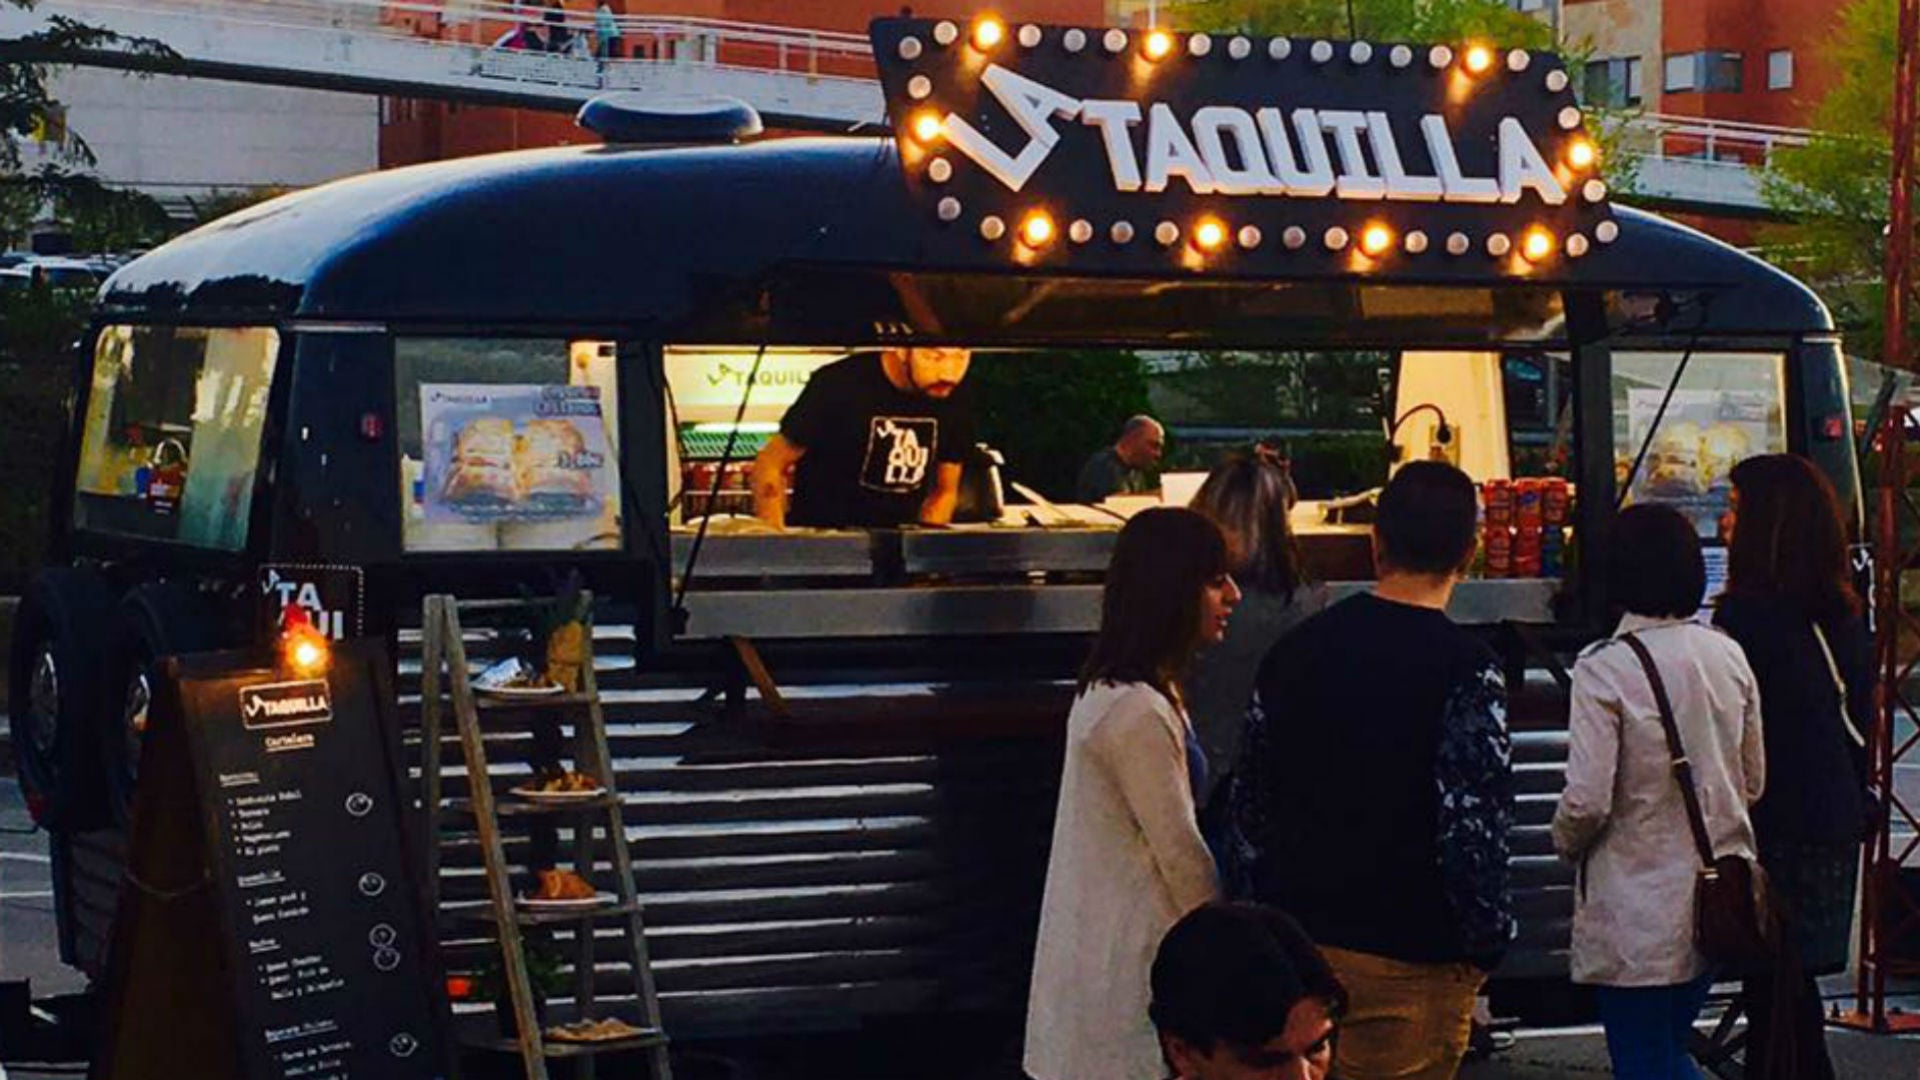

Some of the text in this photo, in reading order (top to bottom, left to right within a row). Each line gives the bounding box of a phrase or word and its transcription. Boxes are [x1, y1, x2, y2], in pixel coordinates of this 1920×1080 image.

[942, 63, 1567, 204] LA TAQUILLA
[735, 370, 808, 386] TQUIL
[275, 582, 321, 611] TA
